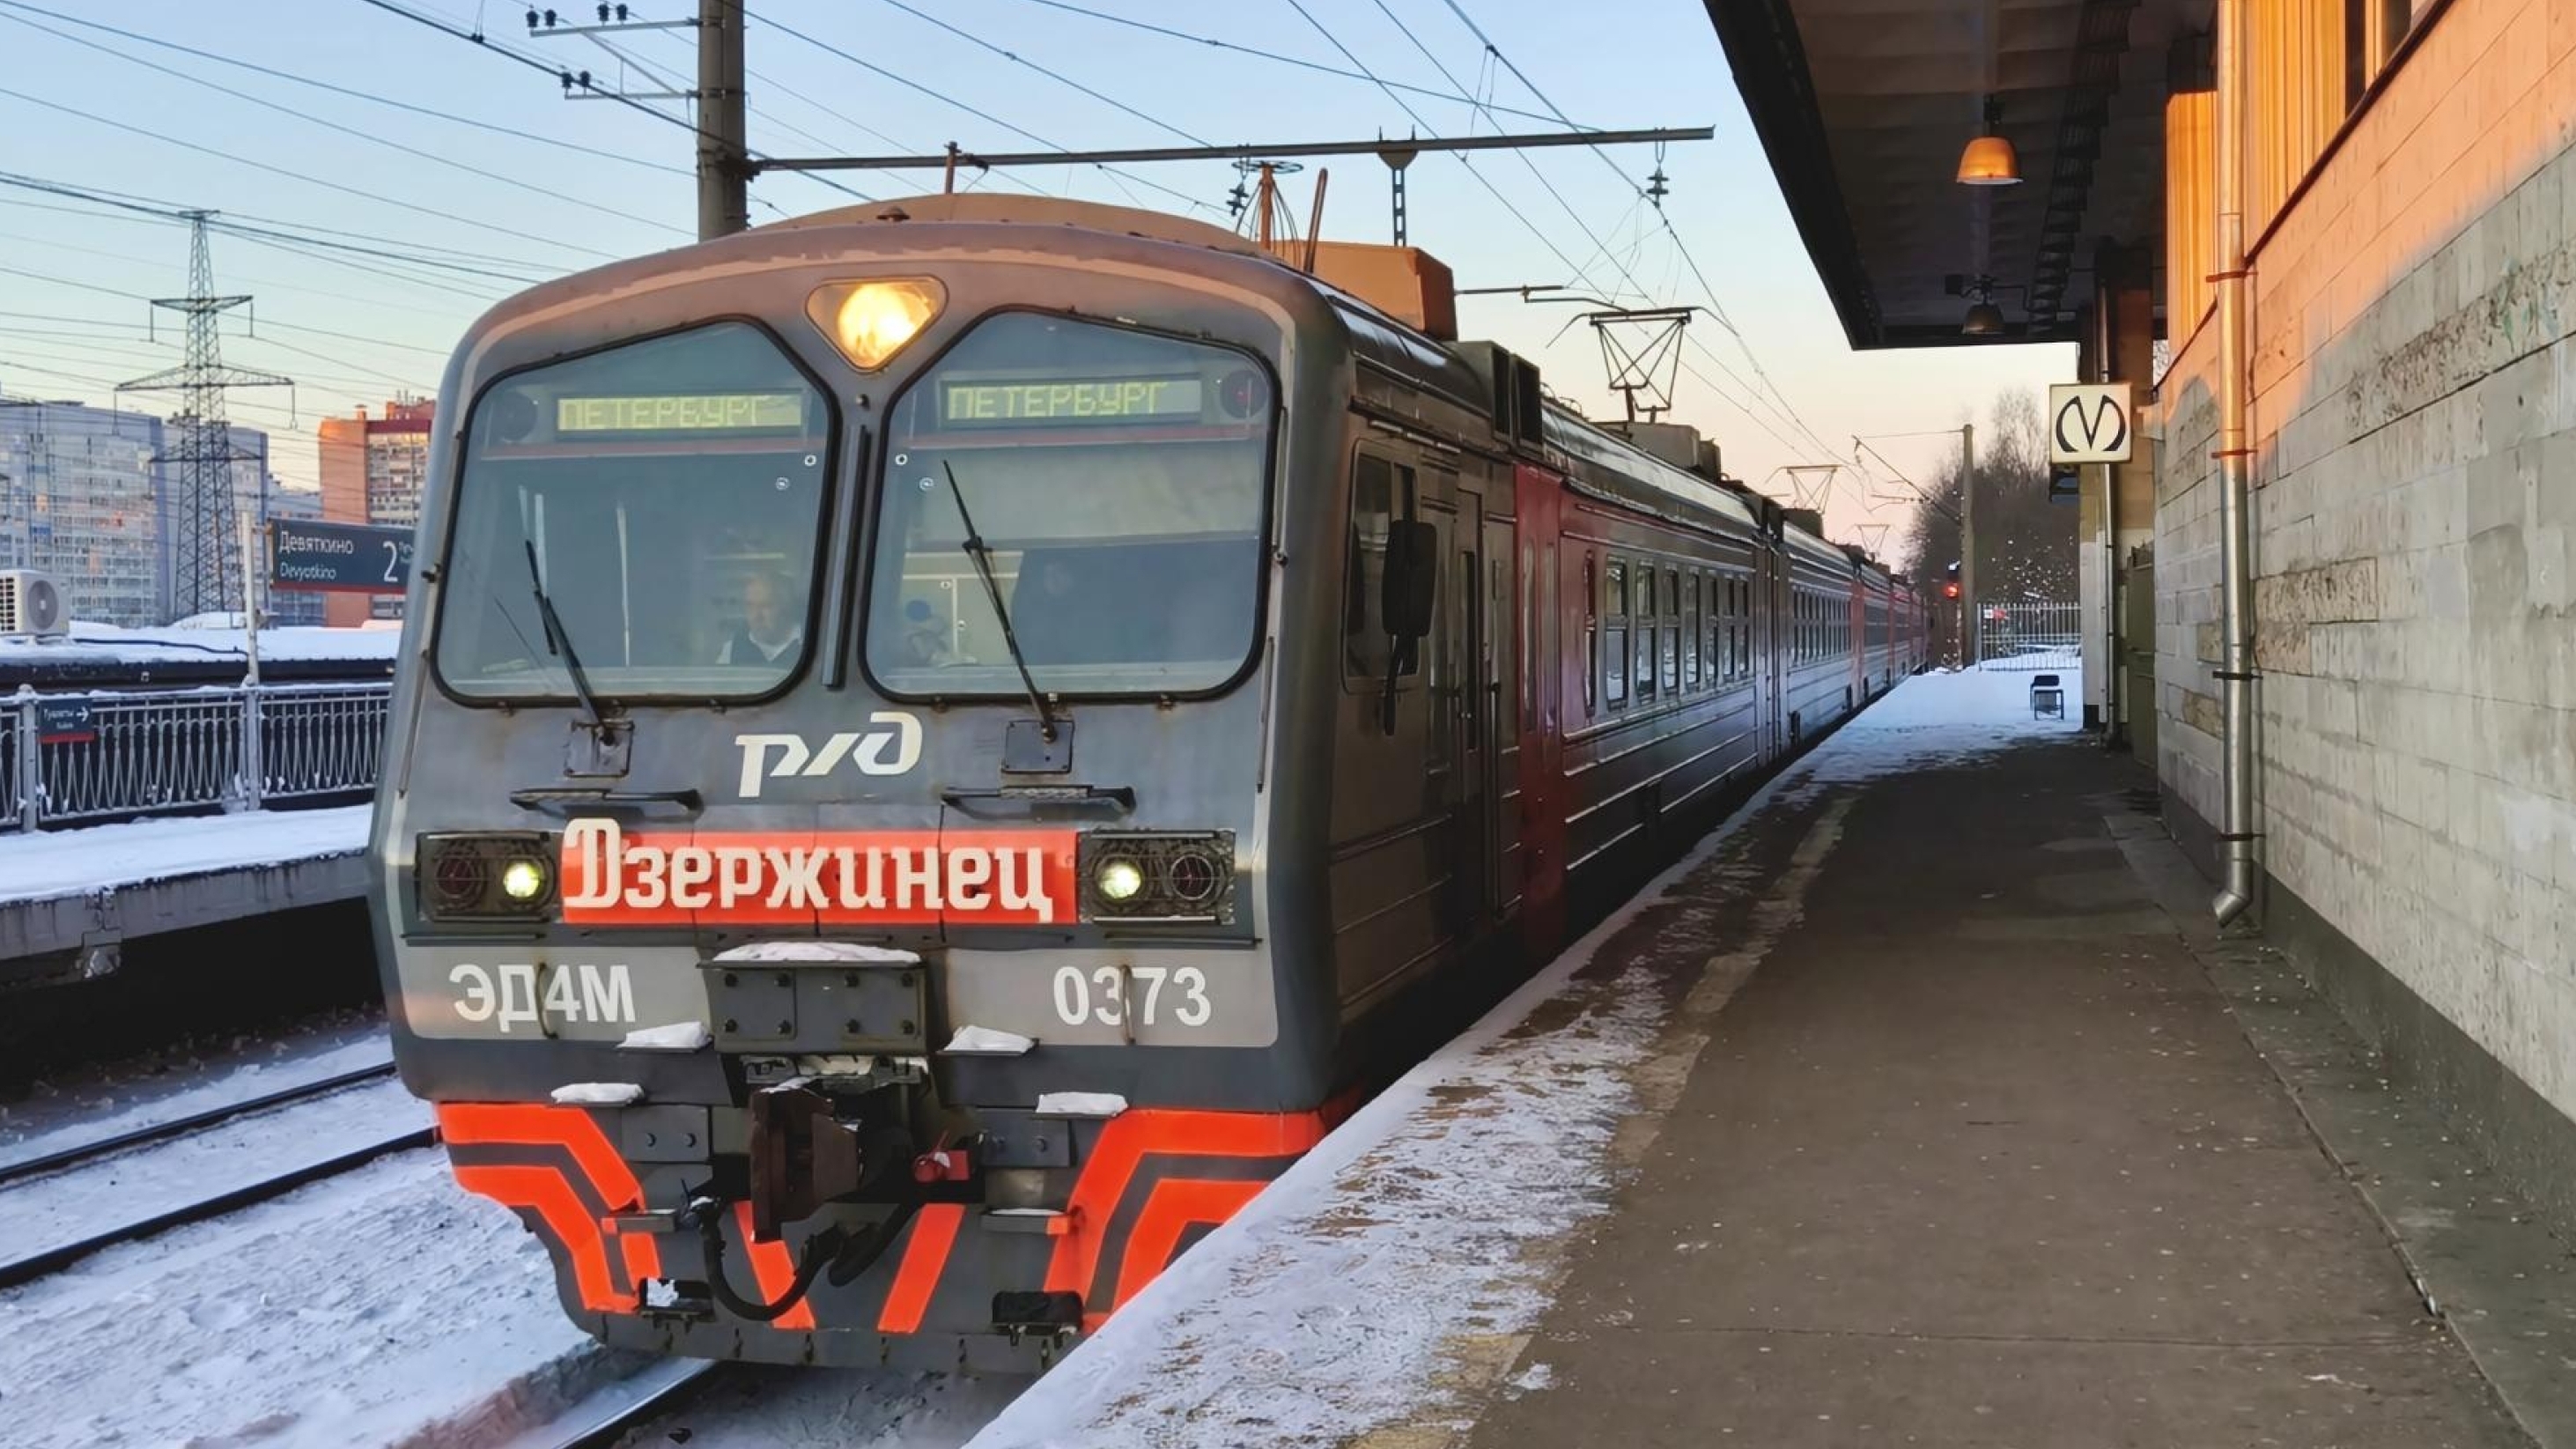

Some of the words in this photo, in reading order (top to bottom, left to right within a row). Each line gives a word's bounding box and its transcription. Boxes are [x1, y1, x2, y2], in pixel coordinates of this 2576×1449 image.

[558, 396, 770, 430] ПЕТЕРБУРГ
[948, 381, 1167, 419] ПЕТЕРБУРГ
[279, 530, 354, 555] Девяткино
[382, 541, 398, 581] 2
[280, 562, 337, 582] Devyatkino
[563, 817, 1054, 924] Дзержинец
[449, 964, 637, 1032] ЭД4М
[1053, 965, 1212, 1026] 0373
